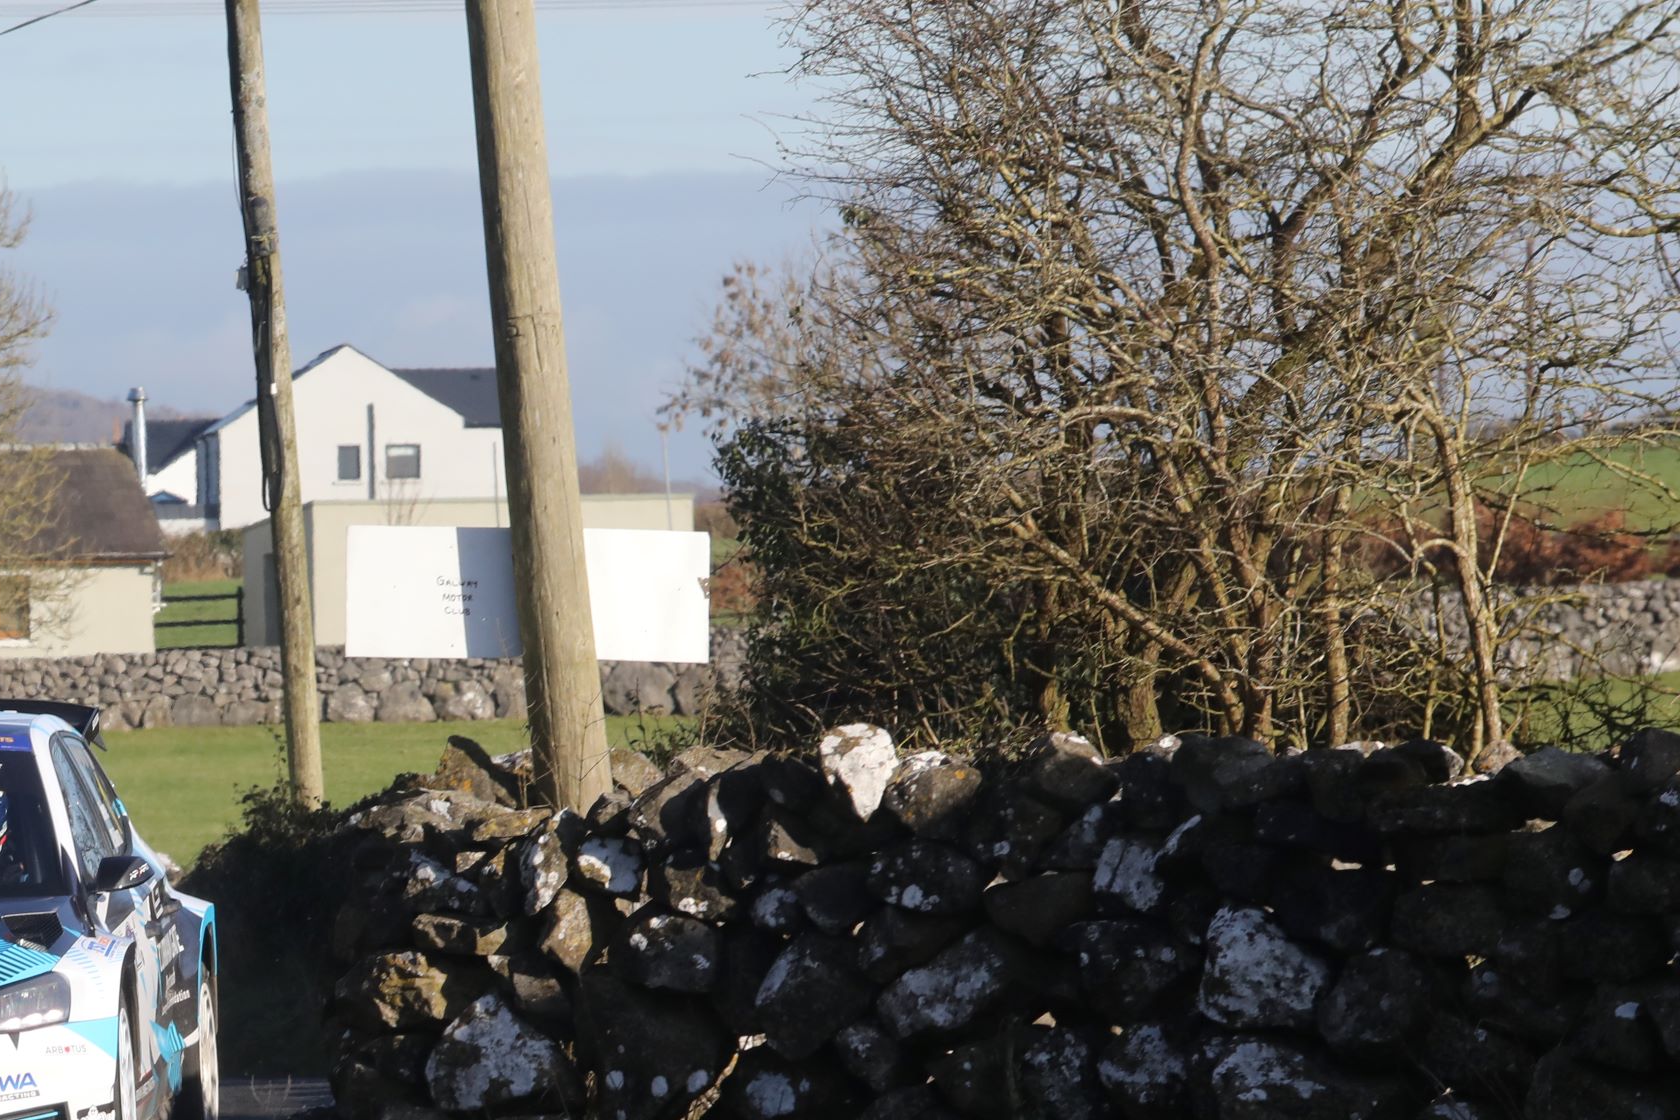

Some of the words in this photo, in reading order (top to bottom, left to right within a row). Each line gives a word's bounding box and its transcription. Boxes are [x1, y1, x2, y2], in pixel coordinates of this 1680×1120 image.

[436, 575, 478, 589] GALWAY
[442, 593, 473, 602] MOTOR
[444, 606, 471, 616] CLUB
